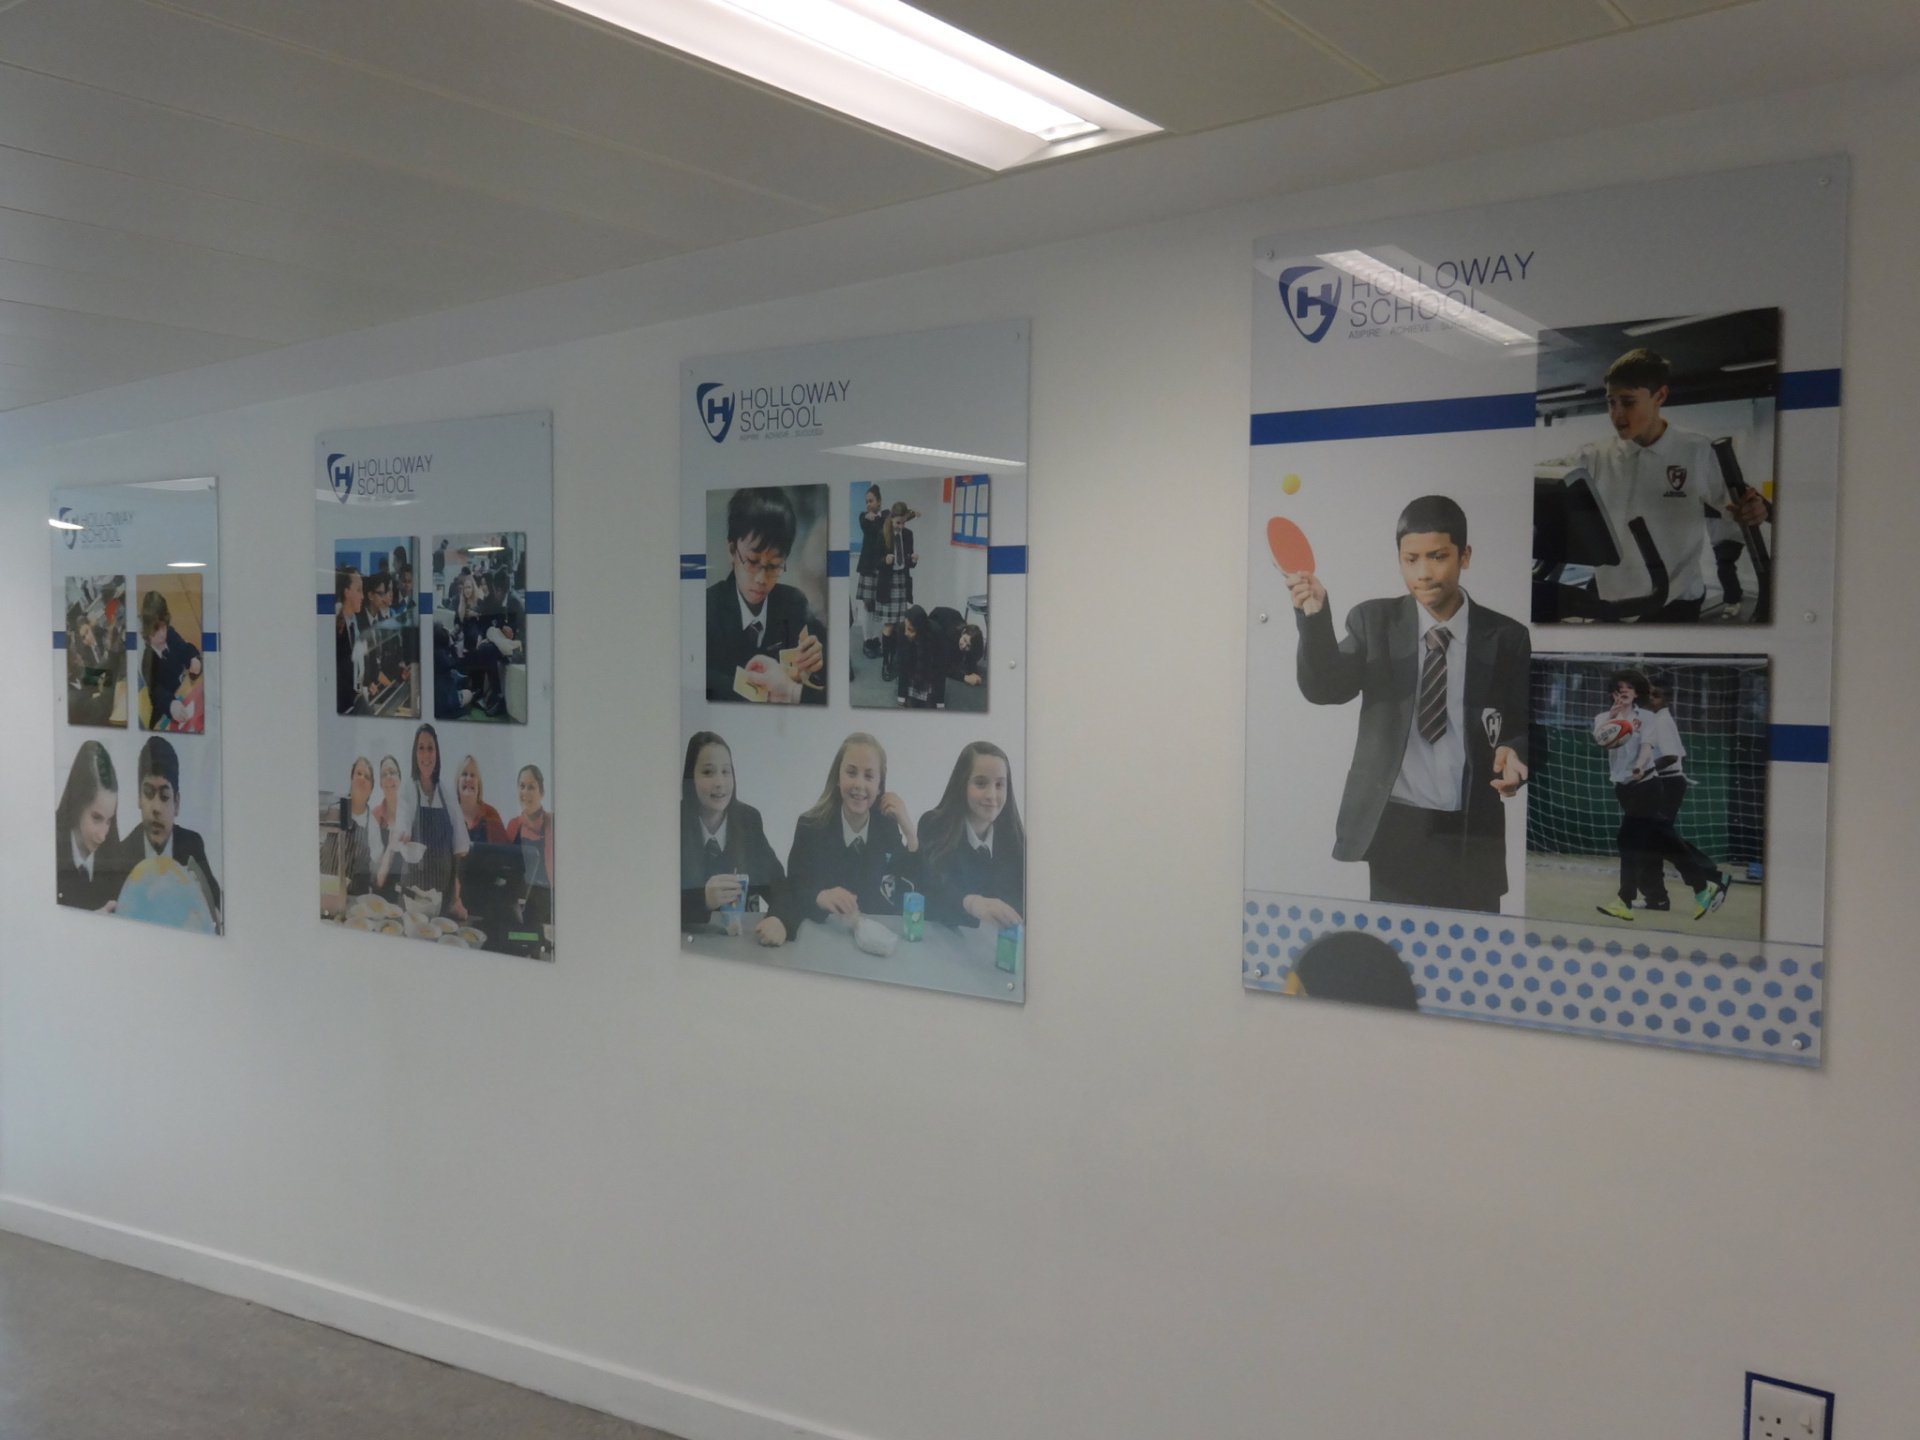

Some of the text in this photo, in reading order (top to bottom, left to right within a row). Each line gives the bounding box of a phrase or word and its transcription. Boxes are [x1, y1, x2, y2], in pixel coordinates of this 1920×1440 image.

[1350, 251, 1535, 300] HOLOWAY
[1349, 286, 1487, 328] SCHOOL
[740, 380, 851, 411] HOLLOWAY
[740, 405, 823, 432] SCHOOL
[357, 454, 433, 477] HOLLOWAY
[357, 475, 414, 496] SCHOOL
